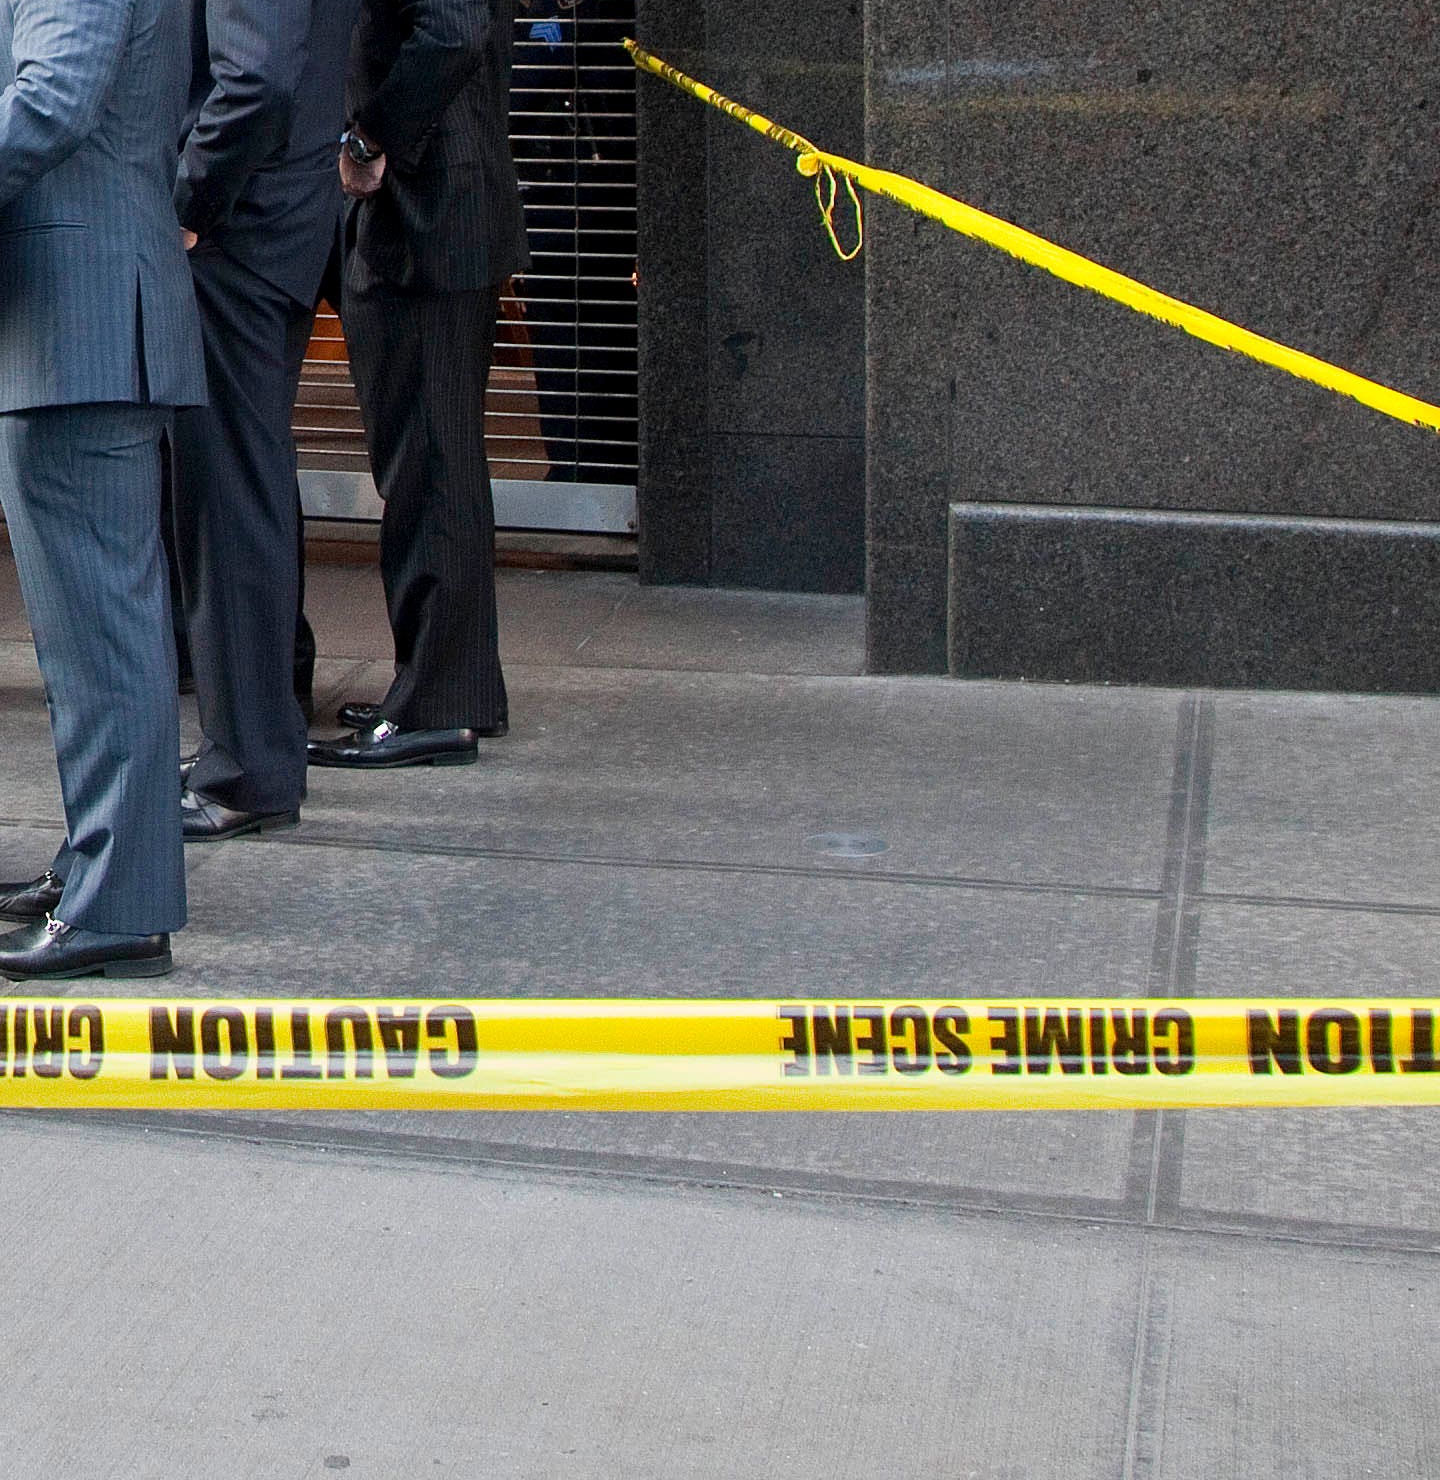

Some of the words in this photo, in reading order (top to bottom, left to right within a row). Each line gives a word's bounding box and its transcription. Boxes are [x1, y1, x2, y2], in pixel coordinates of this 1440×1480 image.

[148, 1003, 480, 1080] CAUTION
[777, 1003, 973, 1077] SCENE
[989, 1004, 1197, 1077] CRIME
